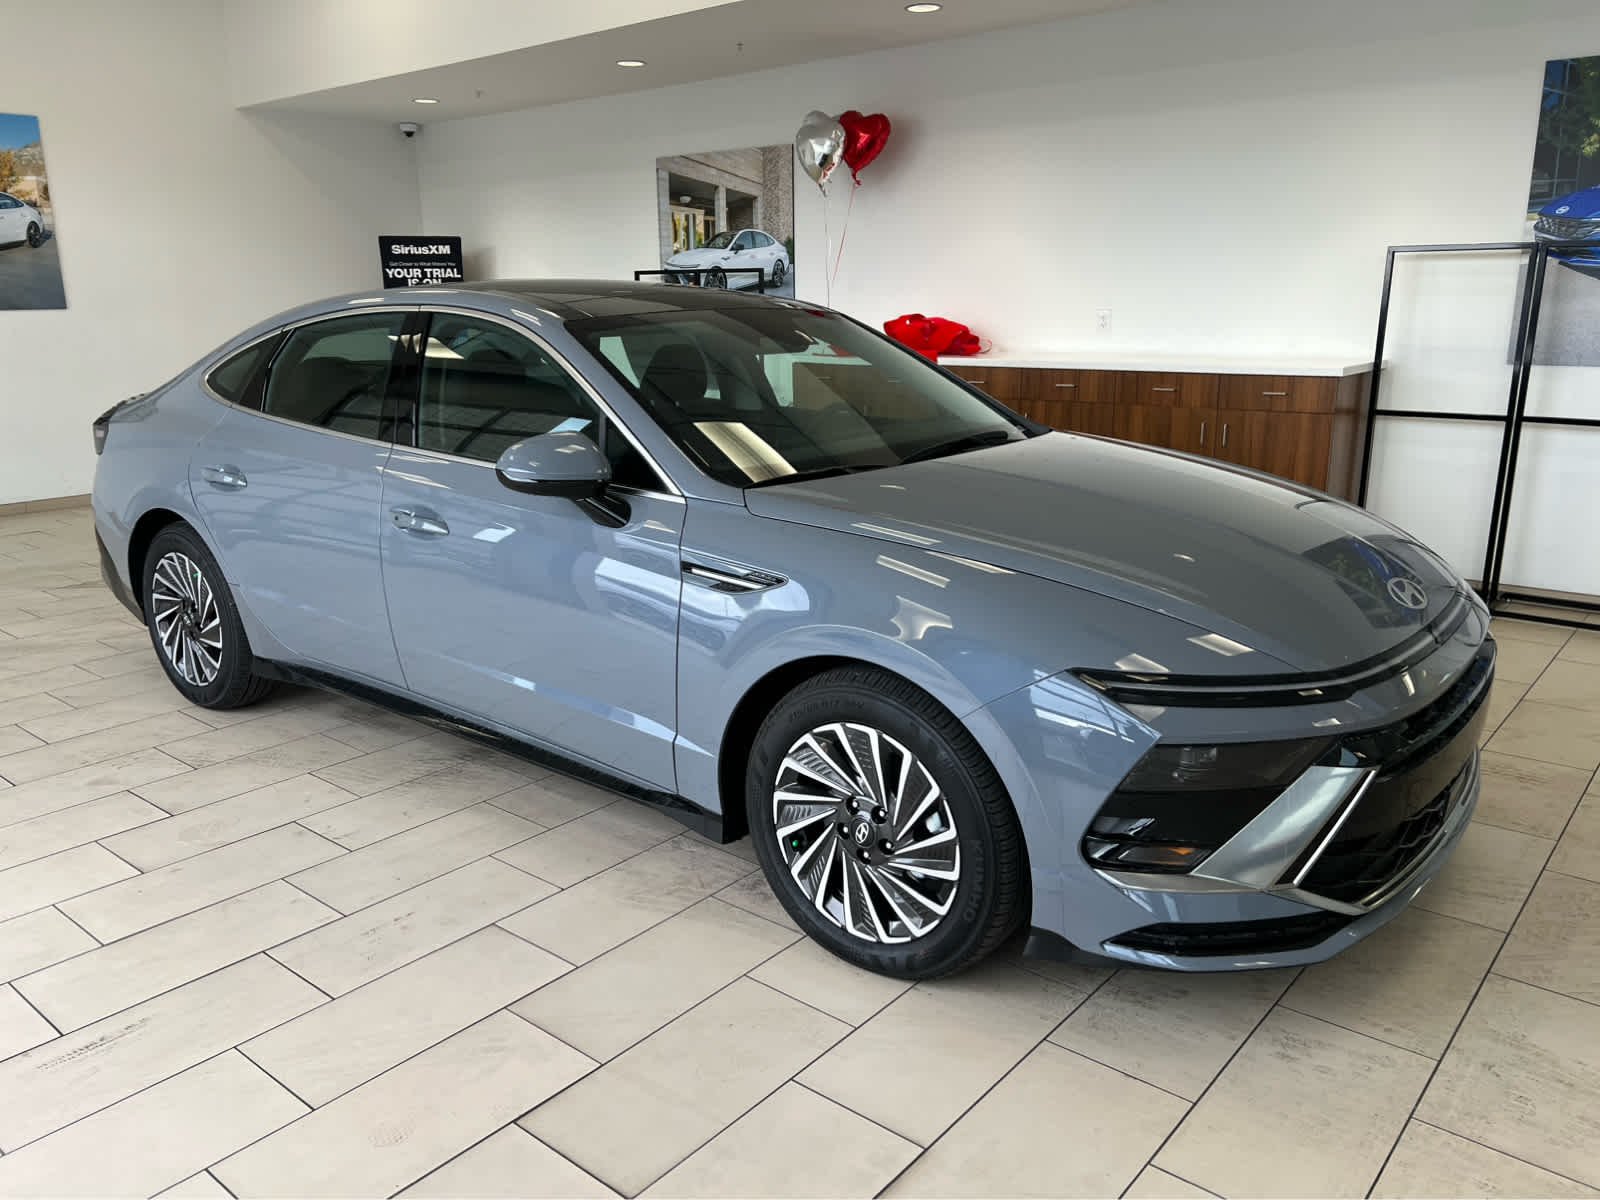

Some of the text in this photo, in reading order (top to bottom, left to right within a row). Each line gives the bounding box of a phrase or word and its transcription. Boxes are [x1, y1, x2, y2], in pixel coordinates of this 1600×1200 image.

[391, 244, 451, 255] SiriusXM
[385, 268, 462, 278] YOUR TRIAL
[408, 279, 419, 287] IS
